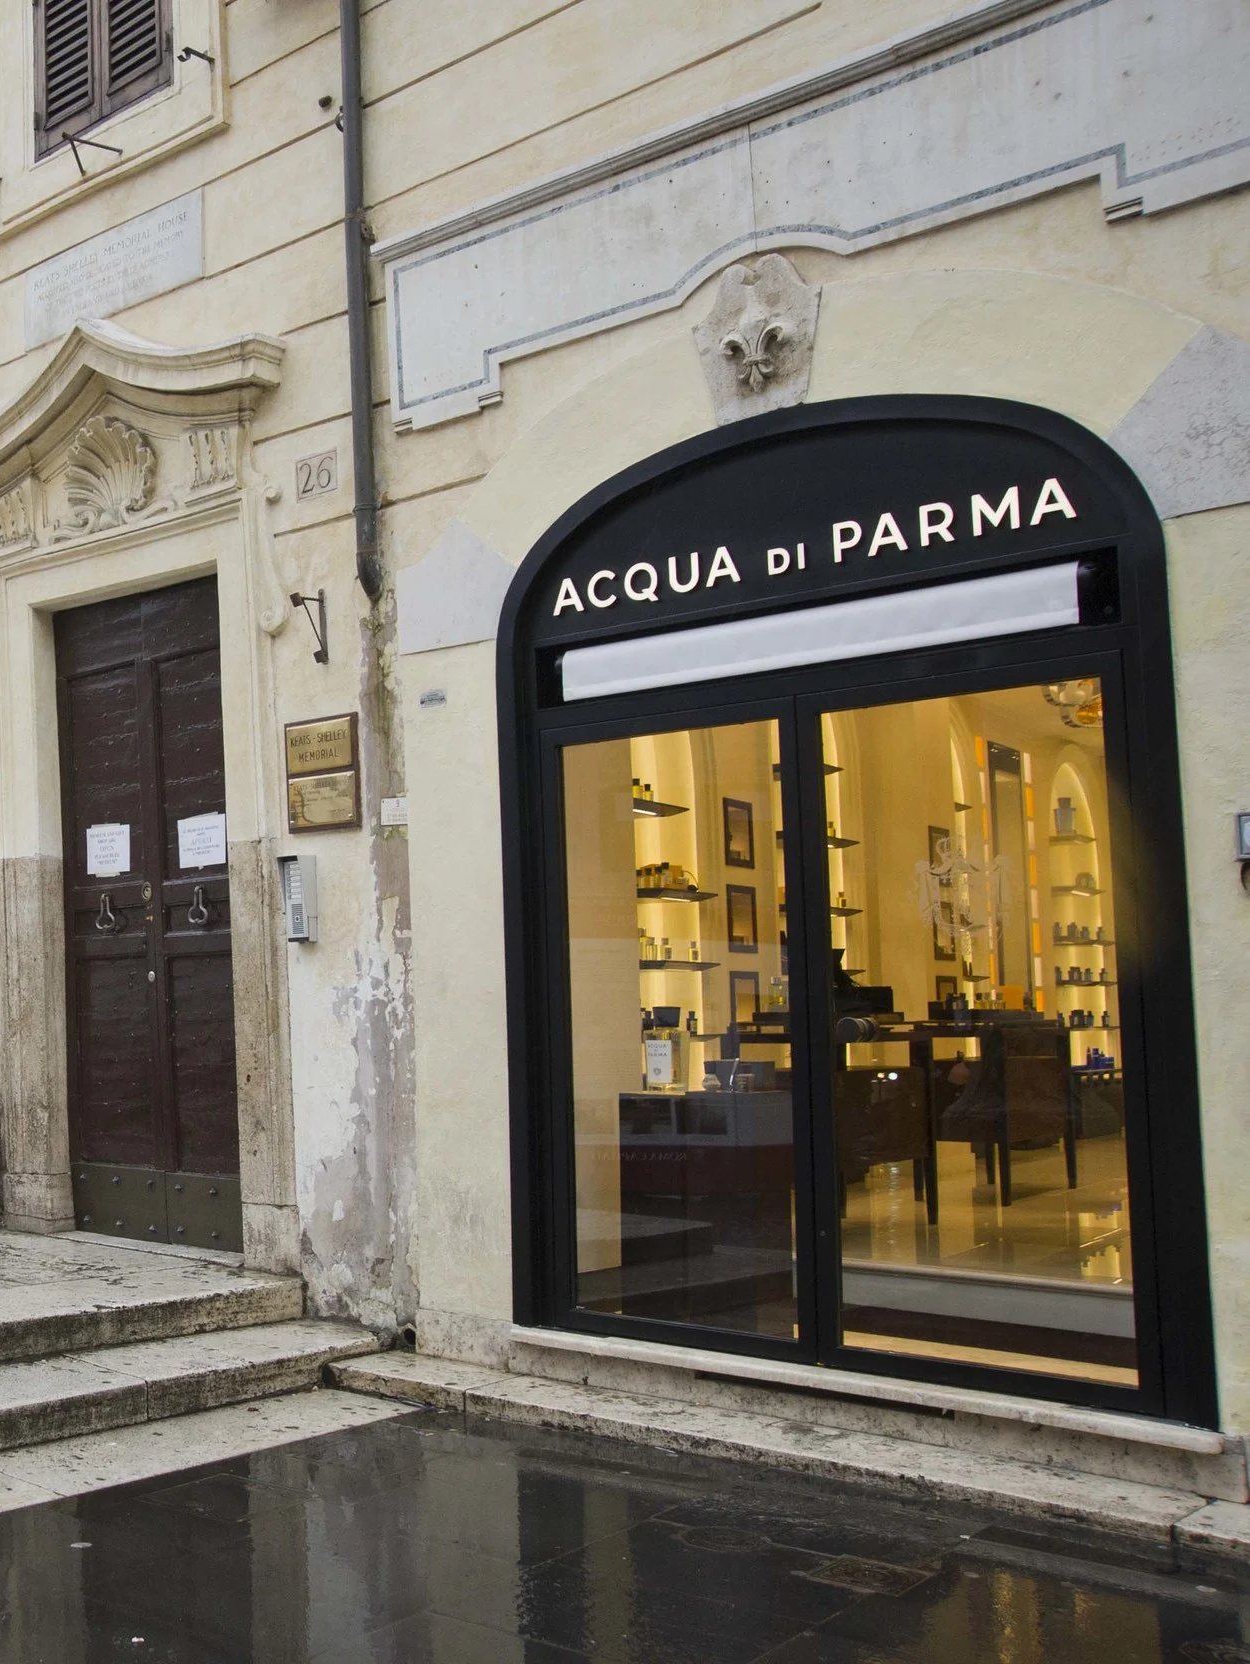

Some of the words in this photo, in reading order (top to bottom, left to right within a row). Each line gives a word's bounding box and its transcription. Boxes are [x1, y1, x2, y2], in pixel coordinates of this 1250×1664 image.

[33, 271, 60, 291] KEATS
[64, 252, 98, 276] SHELLEY
[103, 230, 151, 256] MEMORIAL
[158, 211, 188, 232] HOUSE
[299, 457, 333, 494] 26
[553, 546, 741, 616] ACQUA
[767, 543, 805, 575] DI
[833, 477, 1077, 563] PARMA
[290, 736, 311, 748] KEATS
[317, 729, 347, 743] SHELLEY
[298, 749, 339, 763] MEMORIAL
